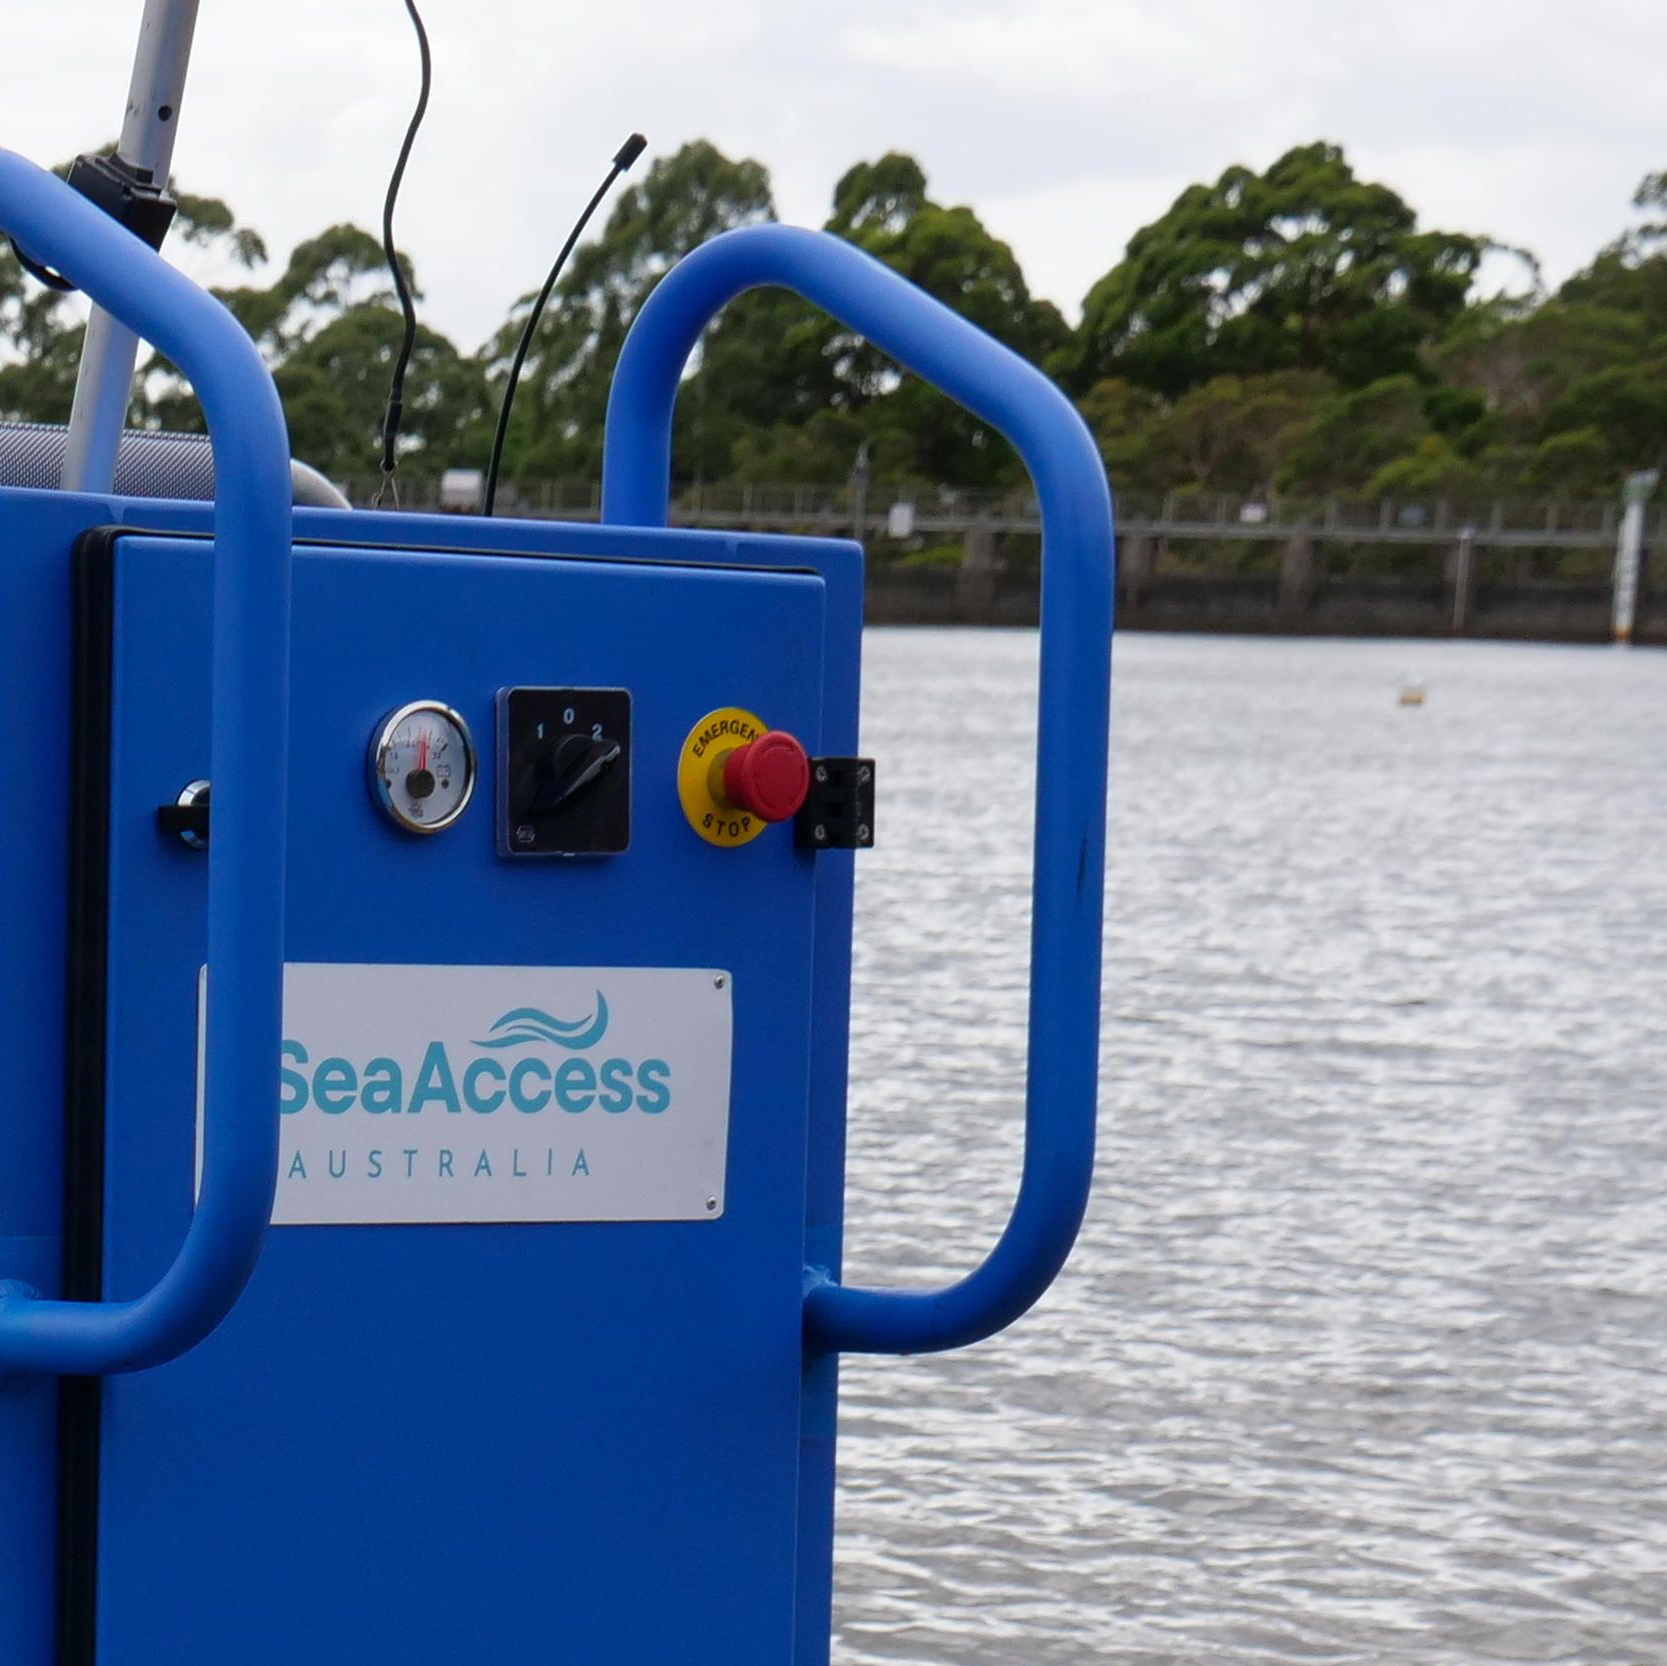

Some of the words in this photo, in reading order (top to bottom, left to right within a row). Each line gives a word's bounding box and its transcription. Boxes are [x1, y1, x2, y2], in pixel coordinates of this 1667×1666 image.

[563, 707, 575, 725] 0
[536, 722, 544, 740] 1
[591, 723, 603, 741] 2
[692, 719, 759, 758] EMERGEN
[702, 813, 751, 838] STOP
[278, 1039, 672, 1115] SeaAccess
[287, 1148, 590, 1179] AUSTRALIA
